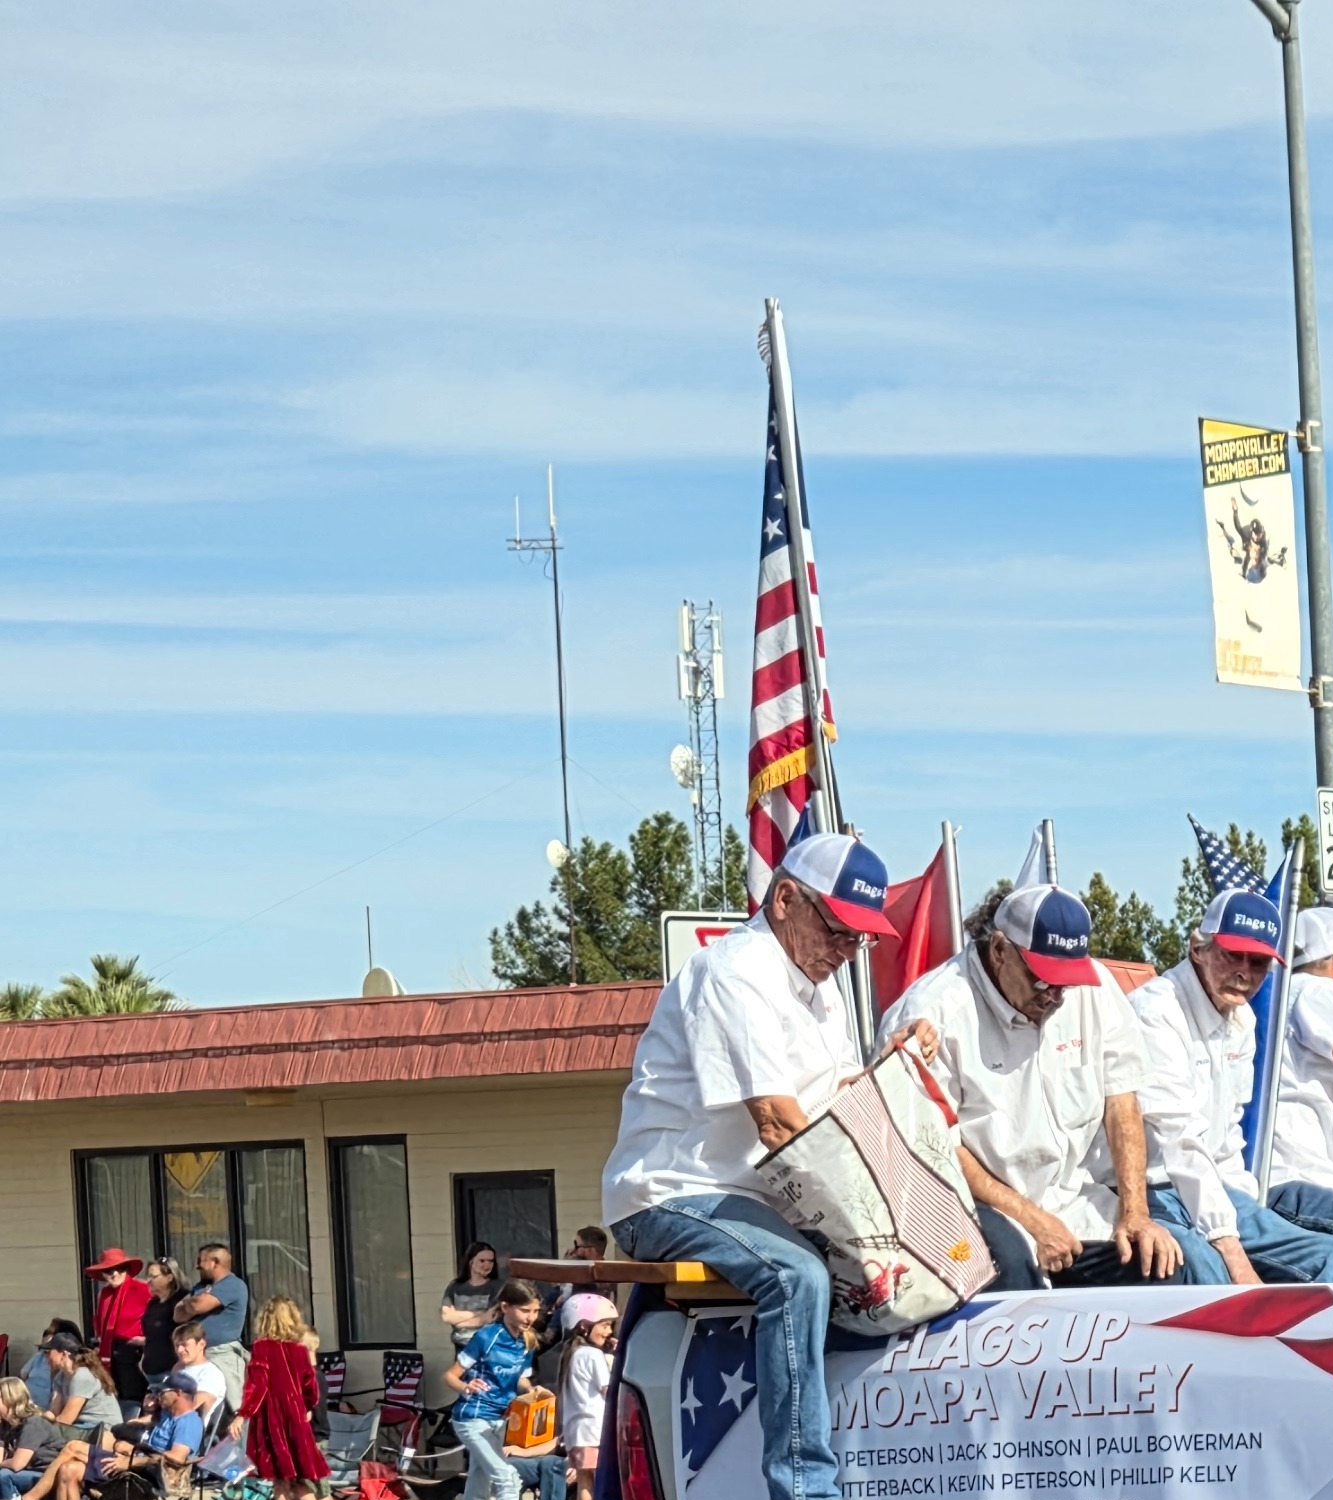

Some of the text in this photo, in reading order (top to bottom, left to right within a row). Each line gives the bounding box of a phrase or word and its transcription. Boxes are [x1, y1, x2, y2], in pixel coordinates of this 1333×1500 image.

[1206, 453, 1286, 484] CHAMBER.COM
[852, 878, 882, 898] Flags
[1234, 913, 1265, 930] Flags
[1047, 933, 1078, 950] Flags
[881, 1310, 1130, 1374] FLAGS UP
[830, 1363, 1194, 1431] MOAPA VALLEY
[845, 1446, 934, 1468] PETERSON
[947, 1442, 987, 1462] JACK
[993, 1438, 1081, 1459] JOHNSON
[1096, 1436, 1143, 1456] PAUL
[1147, 1432, 1263, 1453] BOWERMAN
[948, 1474, 995, 1493] KEVIN
[1002, 1469, 1096, 1490] PETERSON
[1111, 1466, 1174, 1486] PHILLIP
[1180, 1464, 1238, 1483] KELLY
